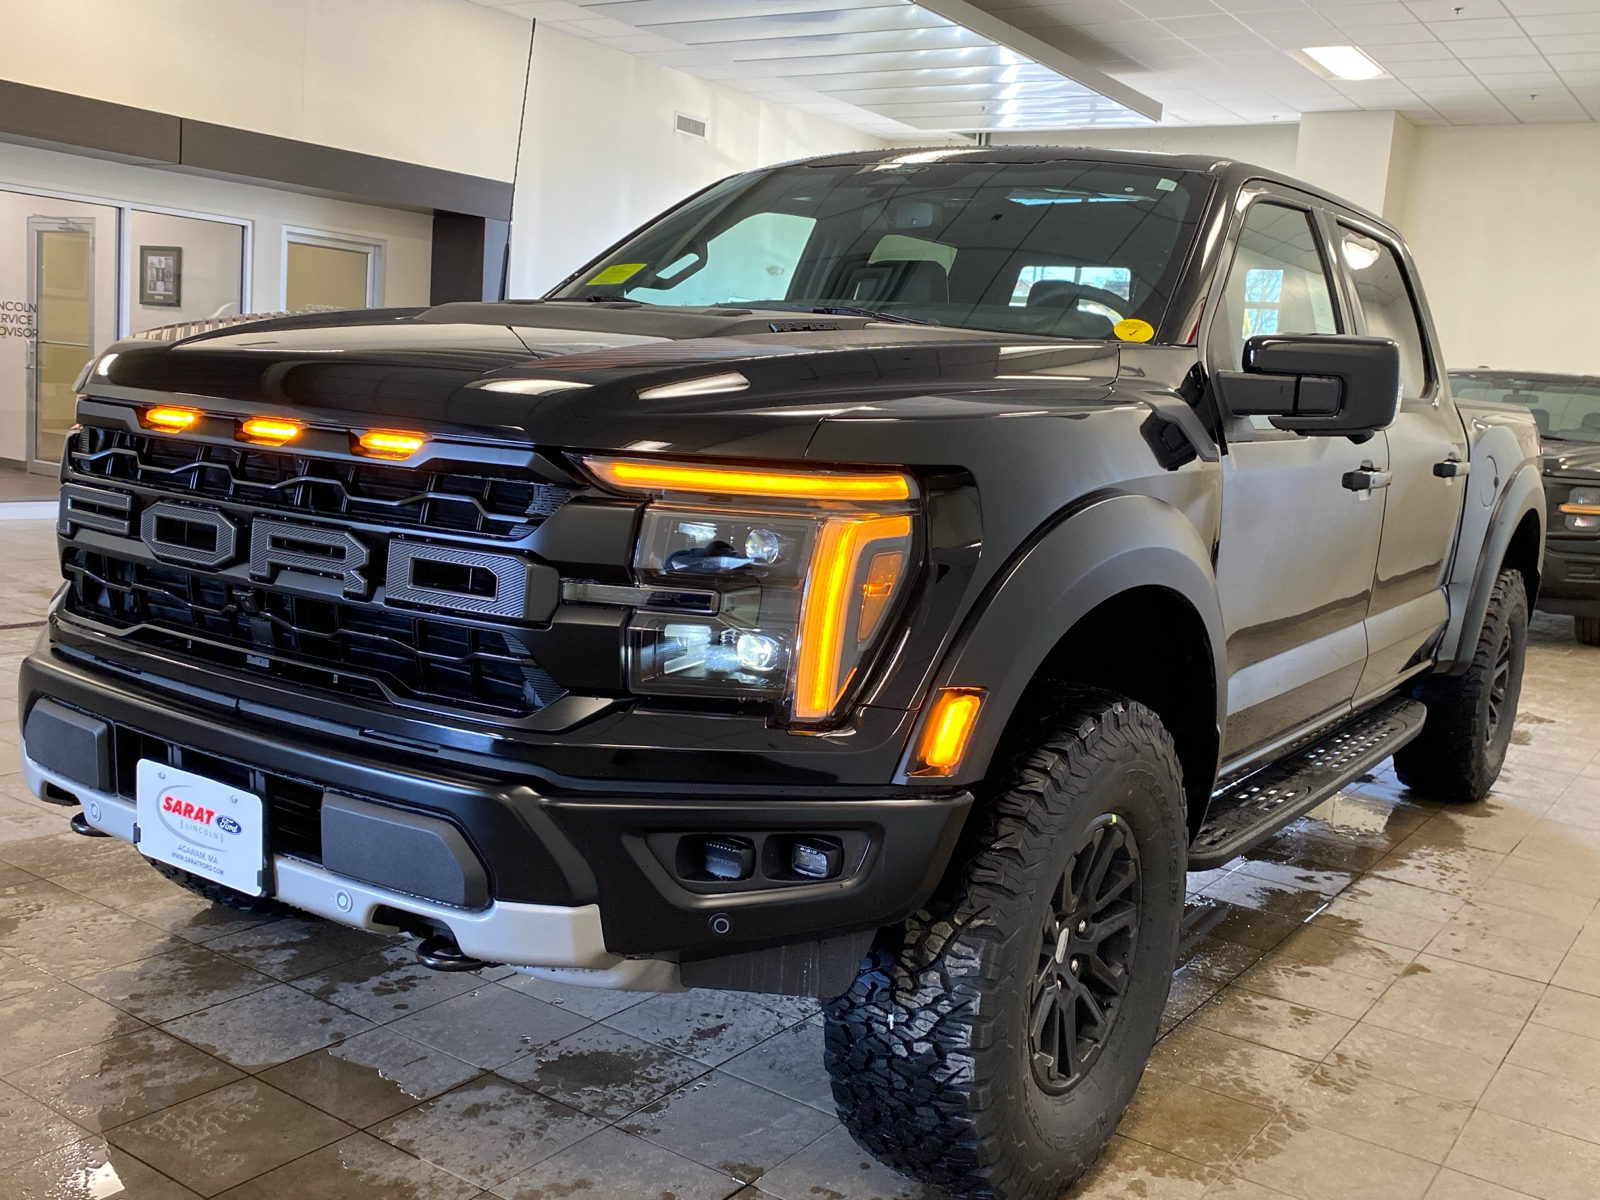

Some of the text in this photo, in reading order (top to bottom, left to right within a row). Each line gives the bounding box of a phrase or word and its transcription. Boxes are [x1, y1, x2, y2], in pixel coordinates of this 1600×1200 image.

[0, 313, 33, 326] RVICE
[57, 482, 528, 619] FORD
[162, 795, 215, 825] SARAT
[185, 822, 219, 840] LINCOLN
[218, 817, 240, 834] Ford
[177, 844, 219, 865] AGAWAM, MA
